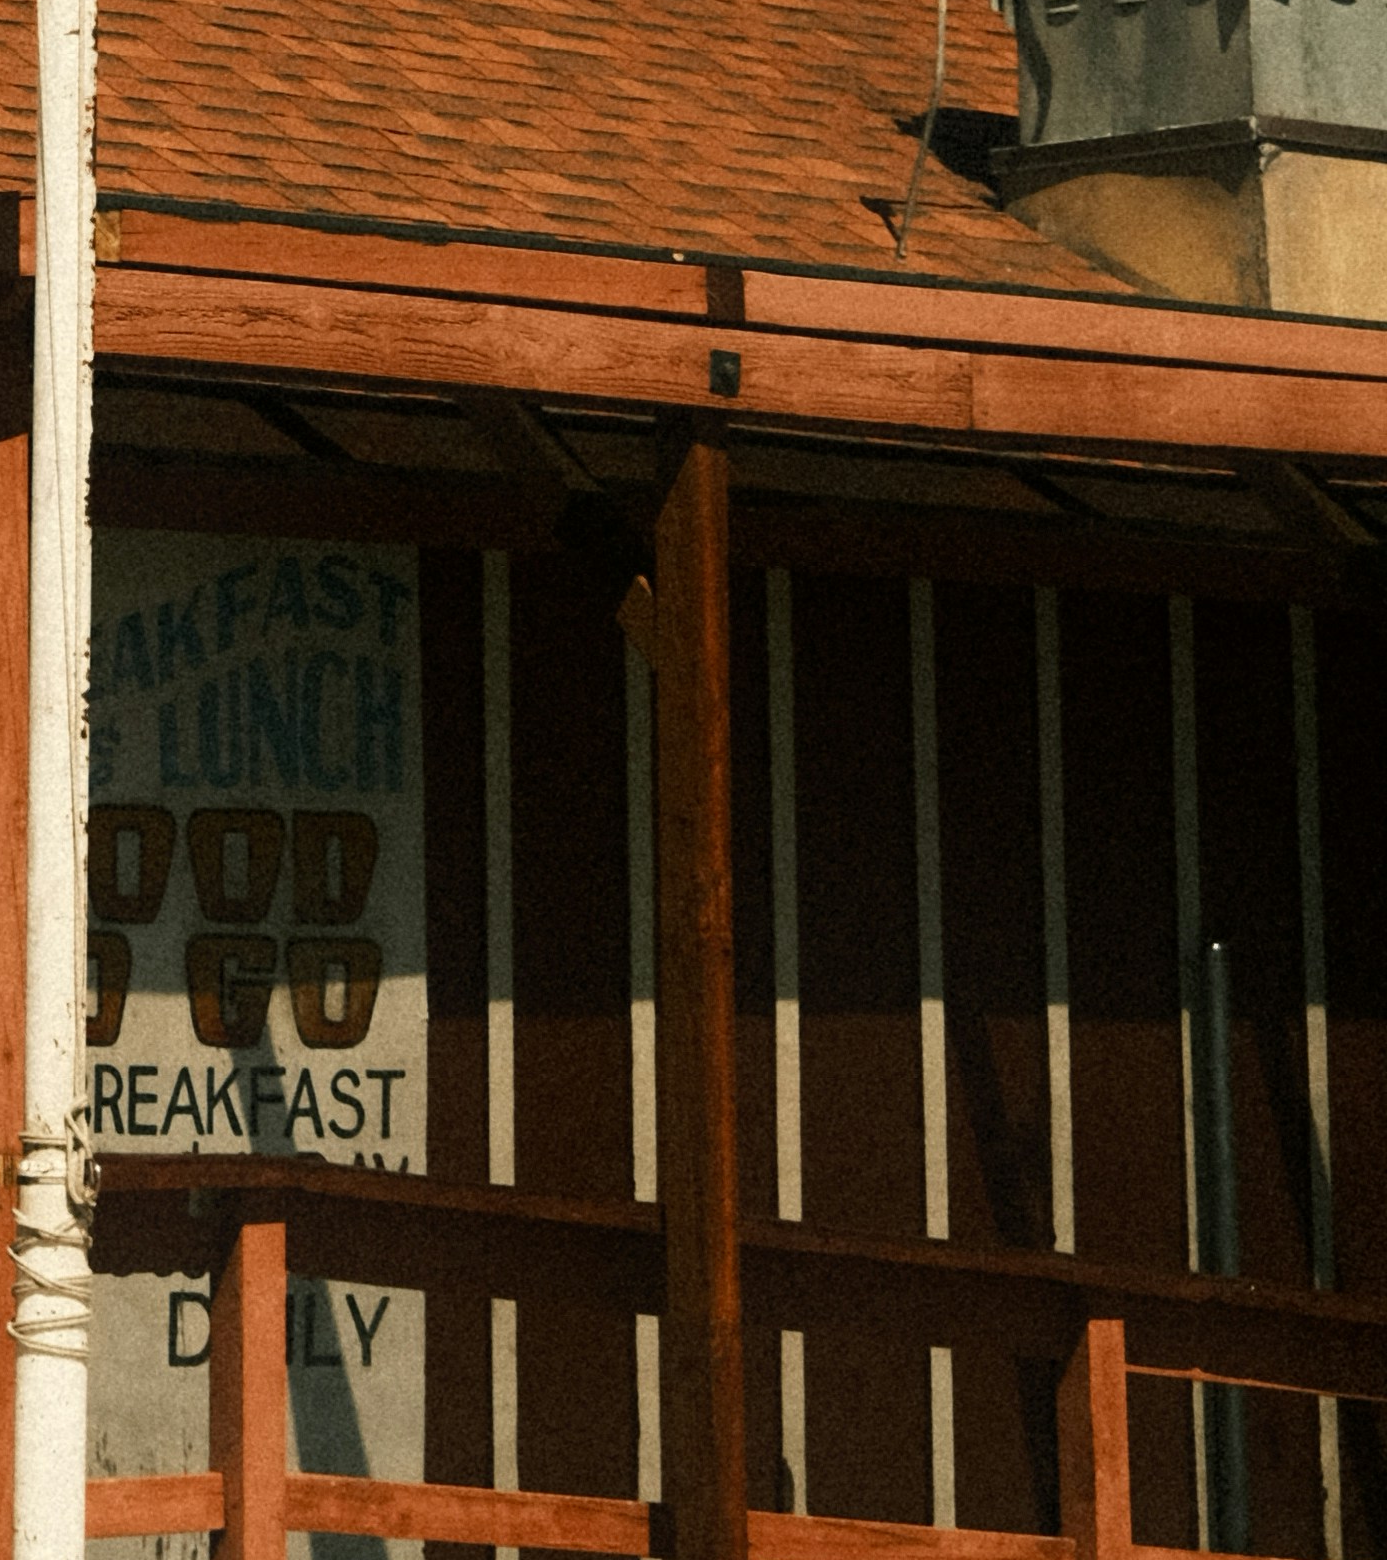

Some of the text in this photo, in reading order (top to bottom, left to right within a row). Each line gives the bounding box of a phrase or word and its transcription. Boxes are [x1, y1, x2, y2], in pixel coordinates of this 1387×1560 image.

[158, 648, 404, 793] LUNCH
[185, 932, 383, 1049] GO
[84, 1064, 405, 1139] REAKFAST
[169, 1291, 390, 1367] DILY
